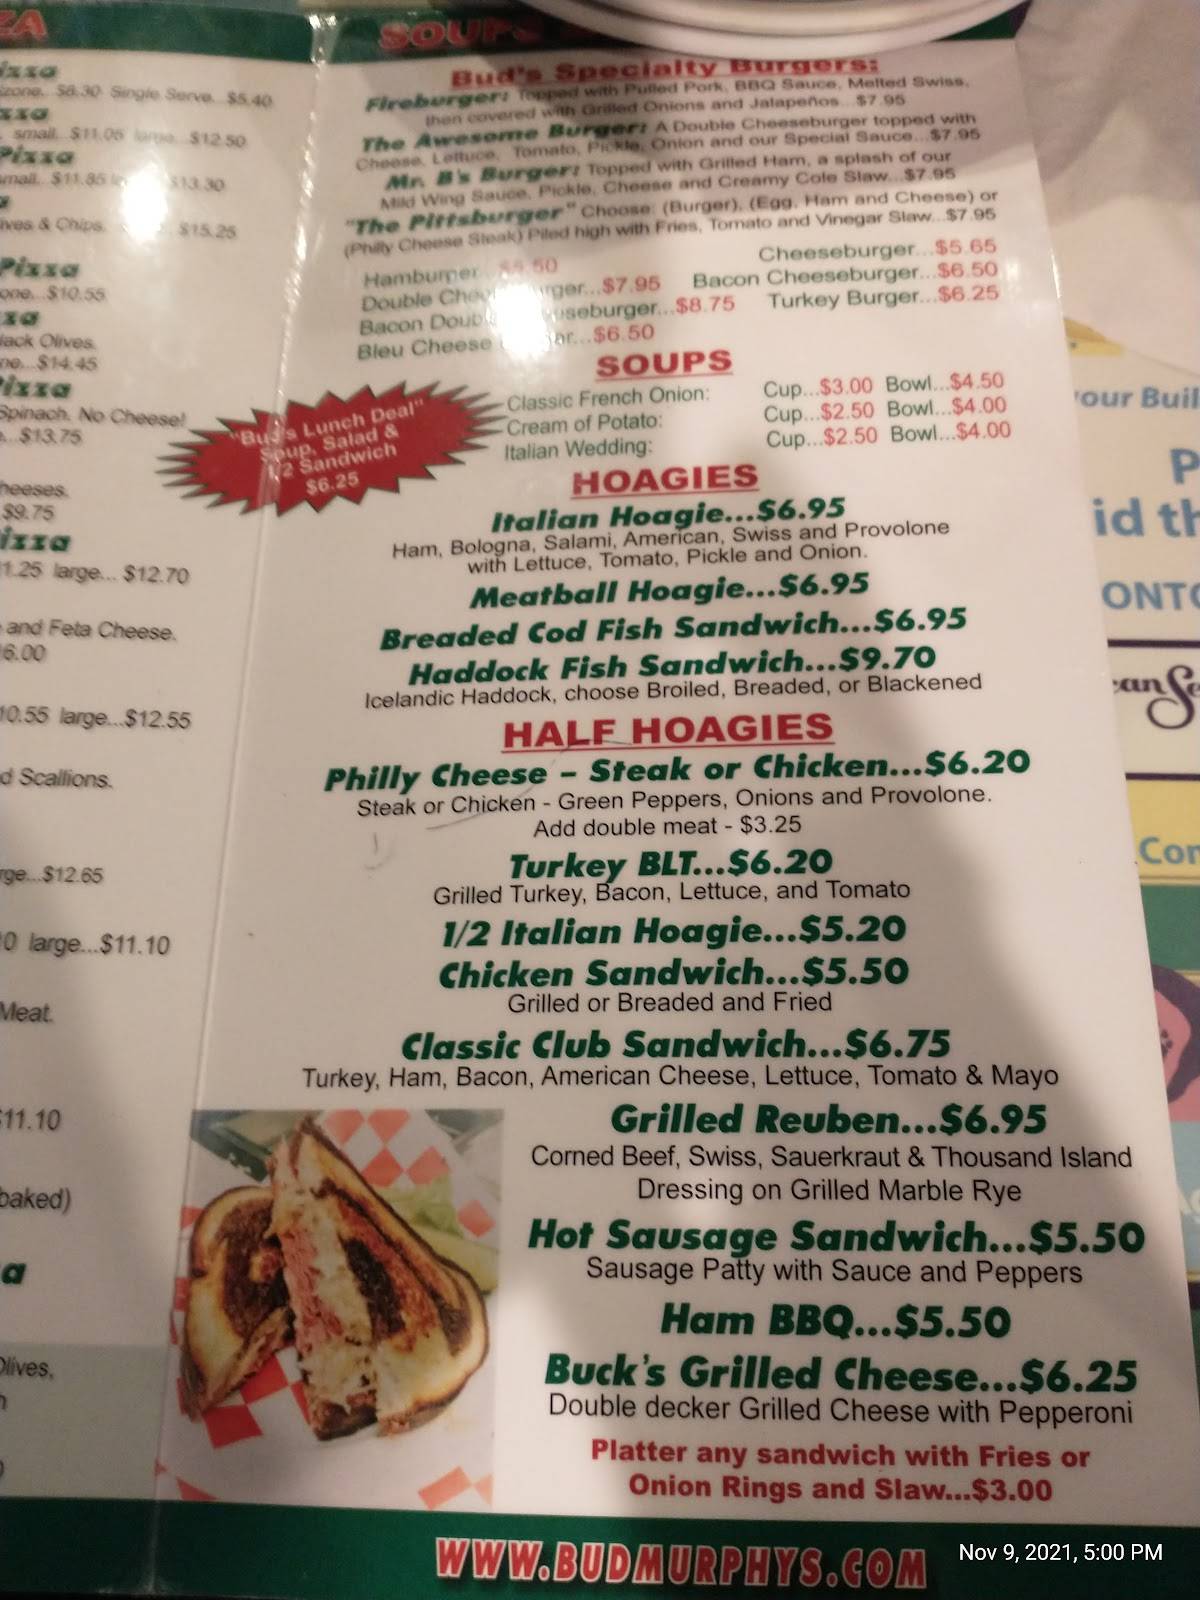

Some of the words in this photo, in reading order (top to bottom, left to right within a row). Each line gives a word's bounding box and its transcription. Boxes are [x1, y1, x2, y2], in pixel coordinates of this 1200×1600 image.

[452, 66, 542, 89] Bud's
[555, 59, 717, 82] Specialty
[365, 90, 510, 113] Fireburger:
[735, 78, 775, 92] BBQ
[848, 76, 907, 88] Melted
[361, 136, 405, 152] The
[415, 128, 539, 148] Awesome
[673, 117, 735, 132] Double
[742, 114, 867, 132] Cheeseburger
[873, 113, 935, 130] topped
[940, 112, 976, 125] with
[693, 271, 759, 288] Bacon
[769, 292, 840, 311] Turkey
[597, 349, 733, 377] SOUPS
[507, 394, 573, 412] Classic
[580, 390, 641, 406] French
[649, 385, 710, 404] Onion:
[1074, 389, 1134, 408] our
[79, 407, 104, 423] No
[303, 413, 365, 437] Lunch
[507, 419, 568, 436] Cream
[574, 415, 594, 432] of
[599, 412, 663, 430] Potato:
[323, 430, 378, 453] Salad
[385, 426, 398, 438] &
[300, 444, 397, 473] Sandwich
[305, 471, 359, 496] $6.25
[572, 464, 759, 496] HOAGIES
[492, 509, 598, 532] Italian
[392, 543, 442, 559] Ham,
[450, 537, 535, 557] Bologna,
[544, 533, 617, 550] Salami,
[623, 527, 725, 547] American,
[733, 527, 791, 542] Swiss
[800, 523, 837, 539] and
[845, 521, 949, 537] Provolone
[123, 565, 189, 585] $12.70
[7, 620, 42, 634] and
[49, 619, 91, 637] Feta
[98, 622, 176, 641] Cheese.
[409, 658, 549, 685] Haddock
[561, 655, 627, 680] Fish
[364, 690, 454, 709] Icelandic
[462, 685, 556, 705] Haddock,
[565, 684, 638, 700] choose
[647, 679, 726, 699] Broiled,
[734, 678, 830, 696] Breaded,
[839, 681, 860, 693] or
[868, 673, 982, 692] Blackened
[504, 720, 615, 748] HALF
[632, 712, 833, 745] HOAGIES
[19, 768, 113, 789] Scallions.
[324, 764, 421, 795] Philly
[431, 763, 547, 788] Cheese
[589, 755, 691, 783] Steak
[704, 761, 741, 781] or
[534, 820, 576, 838] Add
[583, 818, 656, 837] double
[664, 818, 718, 835] meat
[740, 815, 802, 835] $3.25
[510, 852, 626, 883] Turkey
[401, 1030, 521, 1060] Classic
[533, 1029, 611, 1059] Club
[302, 1067, 380, 1092] Turkey,
[389, 1066, 447, 1089] Ham,
[456, 1066, 534, 1089] Bacon,
[541, 1064, 650, 1087] American
[658, 1064, 756, 1088] Cheese,
[765, 1065, 860, 1089] Lettuce,
[868, 1065, 957, 1086] Tomato
[967, 1066, 983, 1086] &
[992, 1064, 1059, 1091] Mayo
[531, 1145, 614, 1167] Corned
[622, 1145, 680, 1169] Beef,
[688, 1146, 763, 1170] Swiss,
[771, 1146, 900, 1168] Sauerkraut
[908, 1147, 925, 1168] &
[931, 1146, 1052, 1169] Thousand
[1060, 1146, 1132, 1169] Island
[637, 1177, 743, 1205] Dressing
[753, 1184, 781, 1201] on
[791, 1179, 870, 1201] Grilled
[879, 1179, 964, 1202] Marble
[973, 1180, 1022, 1207] Rye
[586, 1256, 694, 1285] Sausage
[703, 1258, 765, 1286] Patty
[773, 1259, 822, 1281] with
[832, 1259, 911, 1281] Sauce
[920, 1260, 966, 1282] and
[977, 1261, 1083, 1288] Peppers
[544, 1353, 665, 1387] Buck's
[680, 1353, 822, 1391] Grilled
[549, 1392, 636, 1418] Double
[645, 1395, 730, 1420] decker
[739, 1396, 820, 1421] Grilled
[830, 1398, 929, 1423] Cheese
[938, 1400, 990, 1423] with
[1000, 1400, 1133, 1429] Pepperoni
[592, 1438, 685, 1462] Platter
[697, 1444, 747, 1469] any
[757, 1443, 895, 1467] sandwich
[905, 1445, 969, 1467] with
[980, 1445, 1051, 1468] Fries
[1061, 1449, 1090, 1468] or
[629, 1473, 711, 1497] Onion
[722, 1475, 802, 1504] Rings
[812, 1478, 865, 1500] and
[435, 1537, 927, 1590] WWW.BUDMURPHYS.COM
